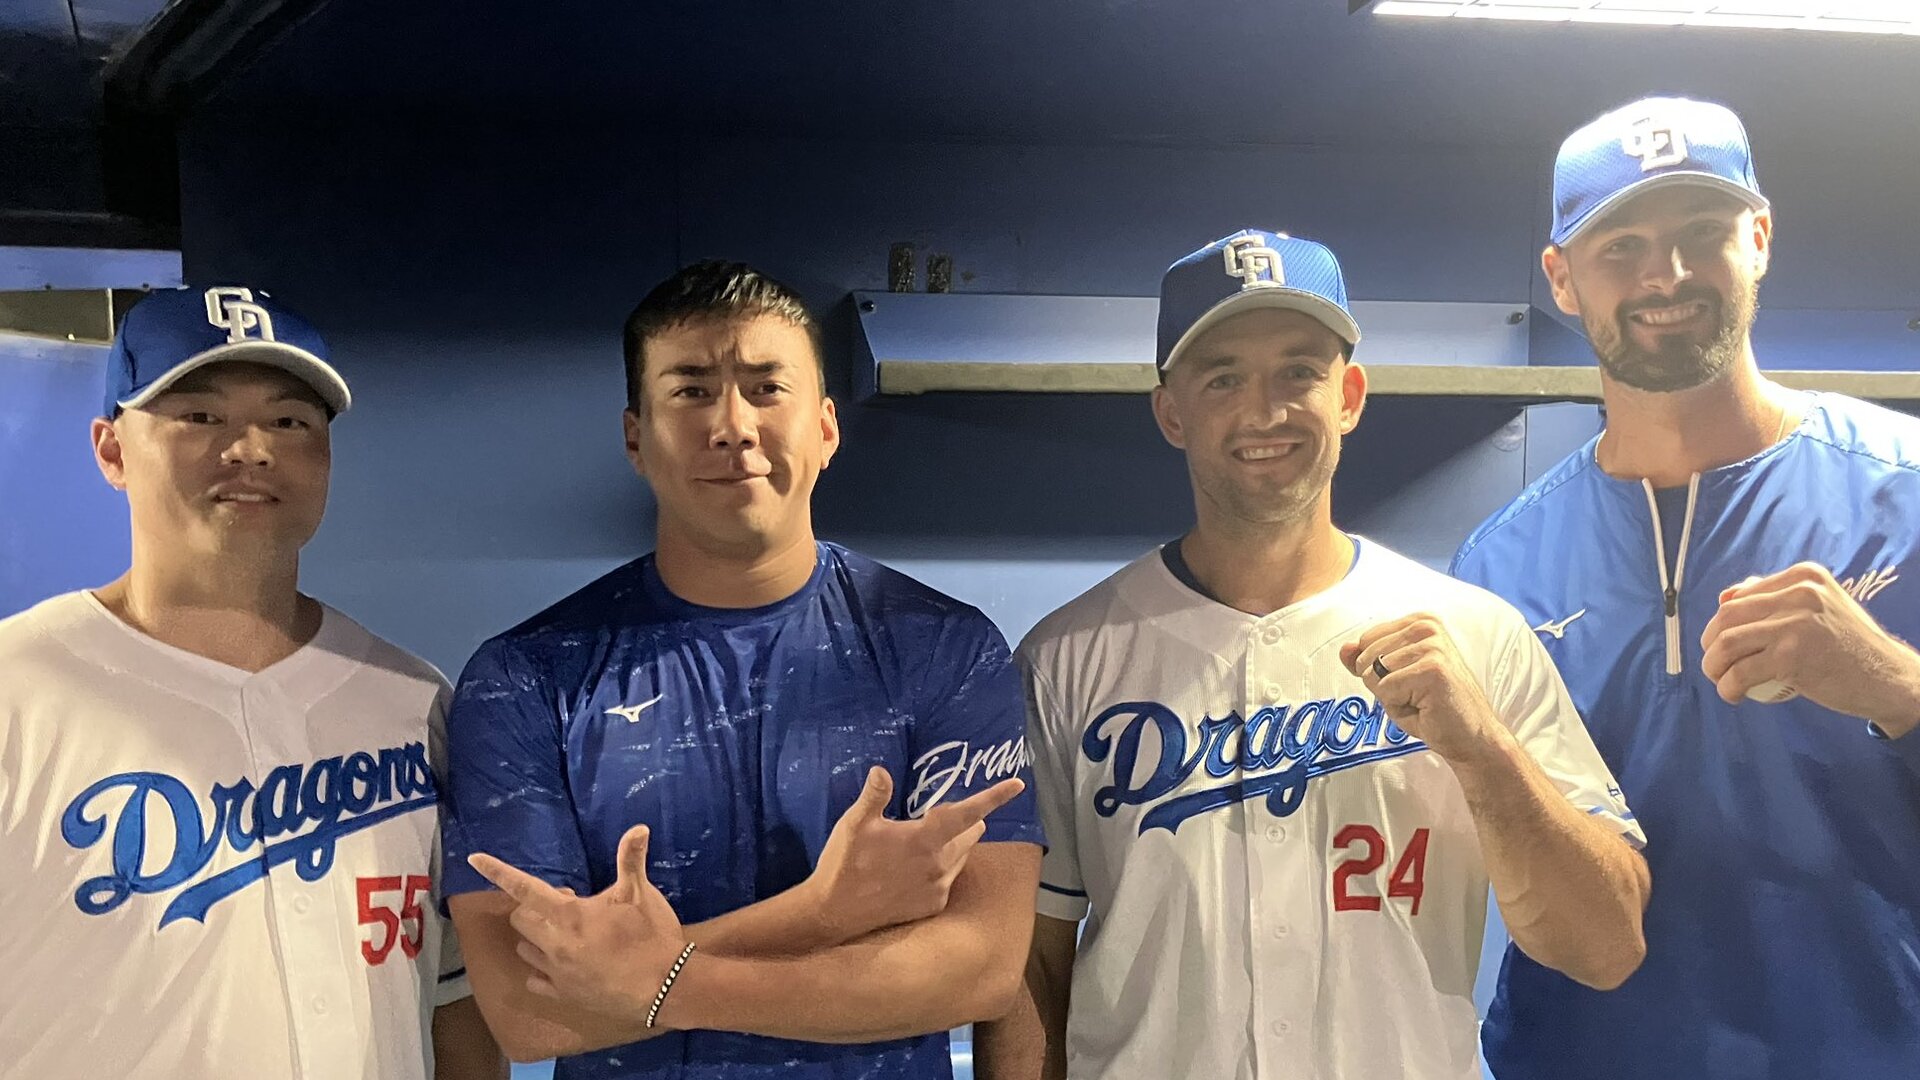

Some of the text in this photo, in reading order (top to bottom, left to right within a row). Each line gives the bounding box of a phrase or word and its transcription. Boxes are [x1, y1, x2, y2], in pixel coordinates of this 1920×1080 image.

[1082, 694, 1410, 818] Dragon
[61, 741, 437, 916] Dragons
[1333, 823, 1431, 916] 24
[356, 875, 432, 966] 55
